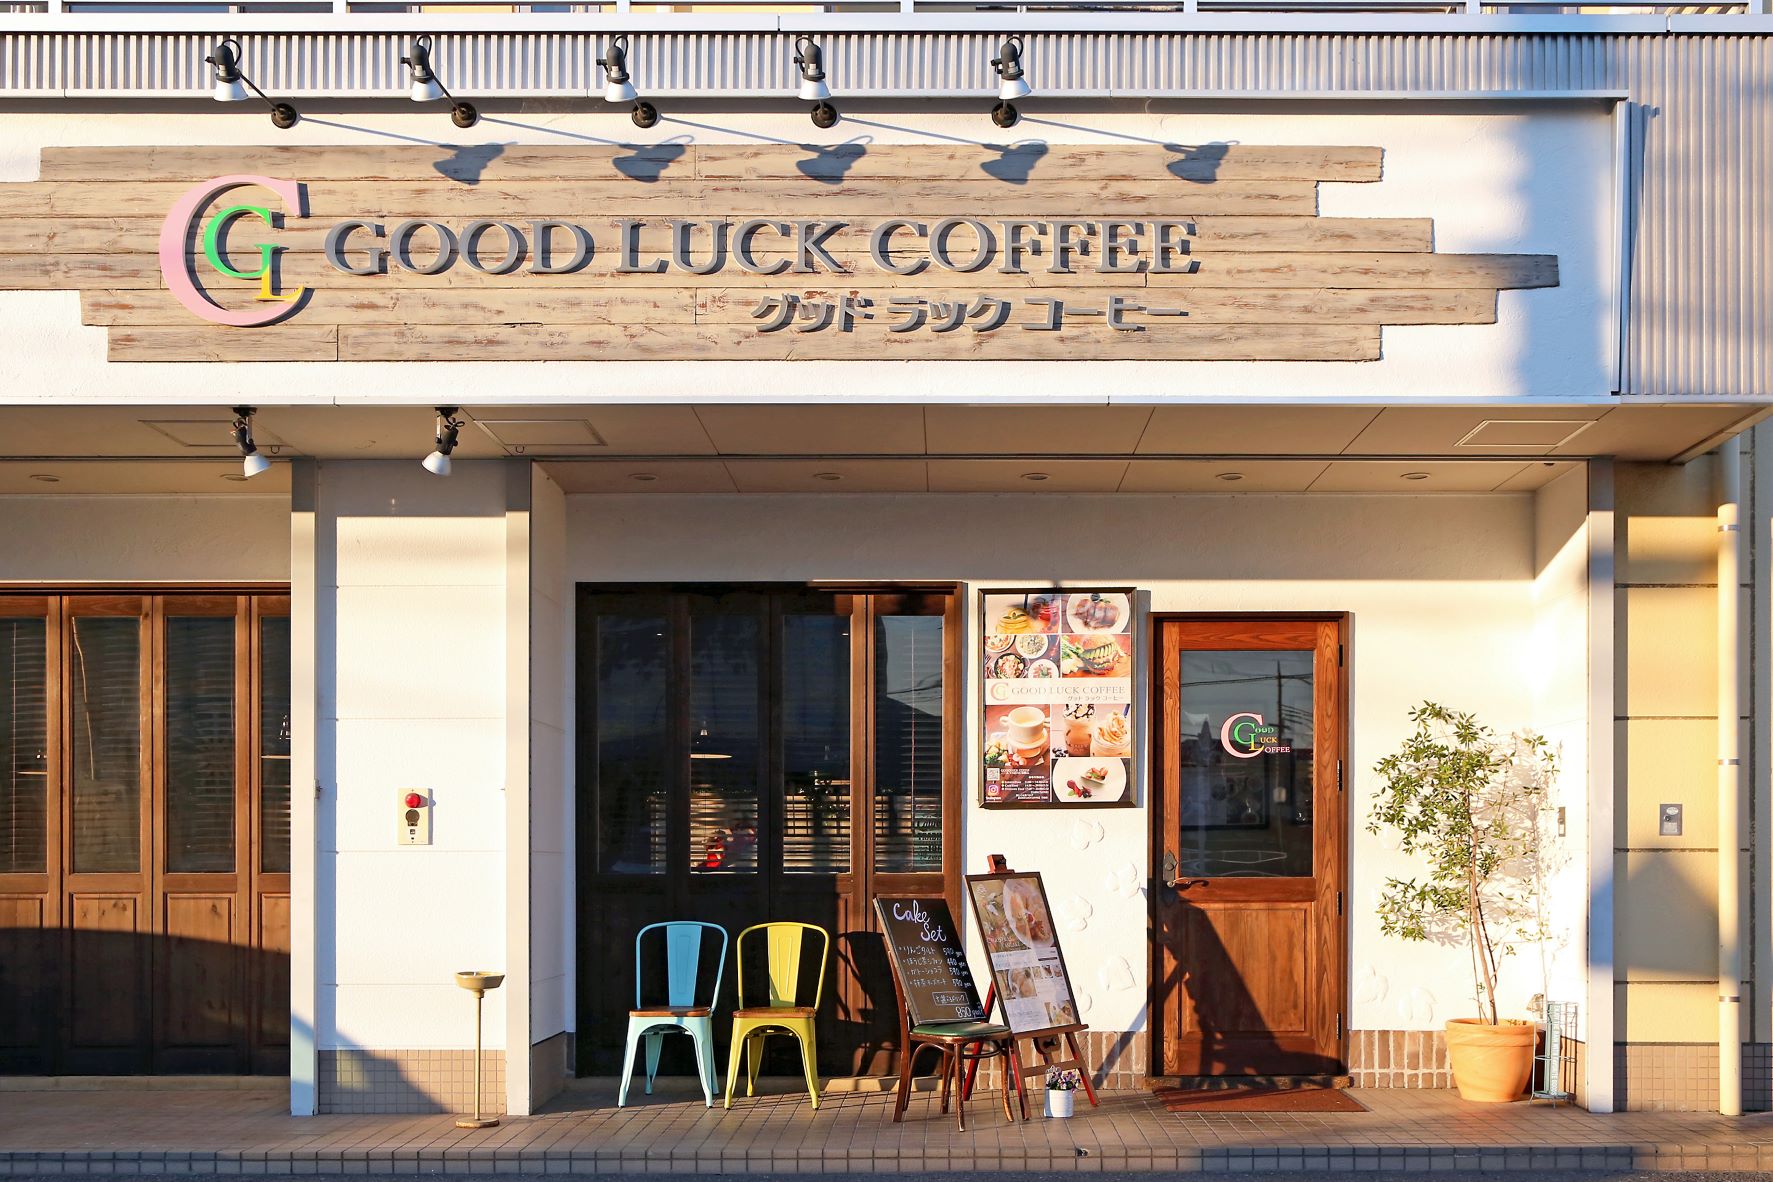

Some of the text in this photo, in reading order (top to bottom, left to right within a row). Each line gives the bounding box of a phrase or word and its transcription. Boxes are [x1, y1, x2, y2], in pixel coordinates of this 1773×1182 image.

[324, 219, 1196, 276] GOOD LUCK COFFEE
[751, 294, 1184, 332] グッド ラック コーヒー
[1011, 686, 1125, 695] GOOD LUCK COFFEE
[893, 900, 930, 924] Cake
[920, 921, 947, 942] Set
